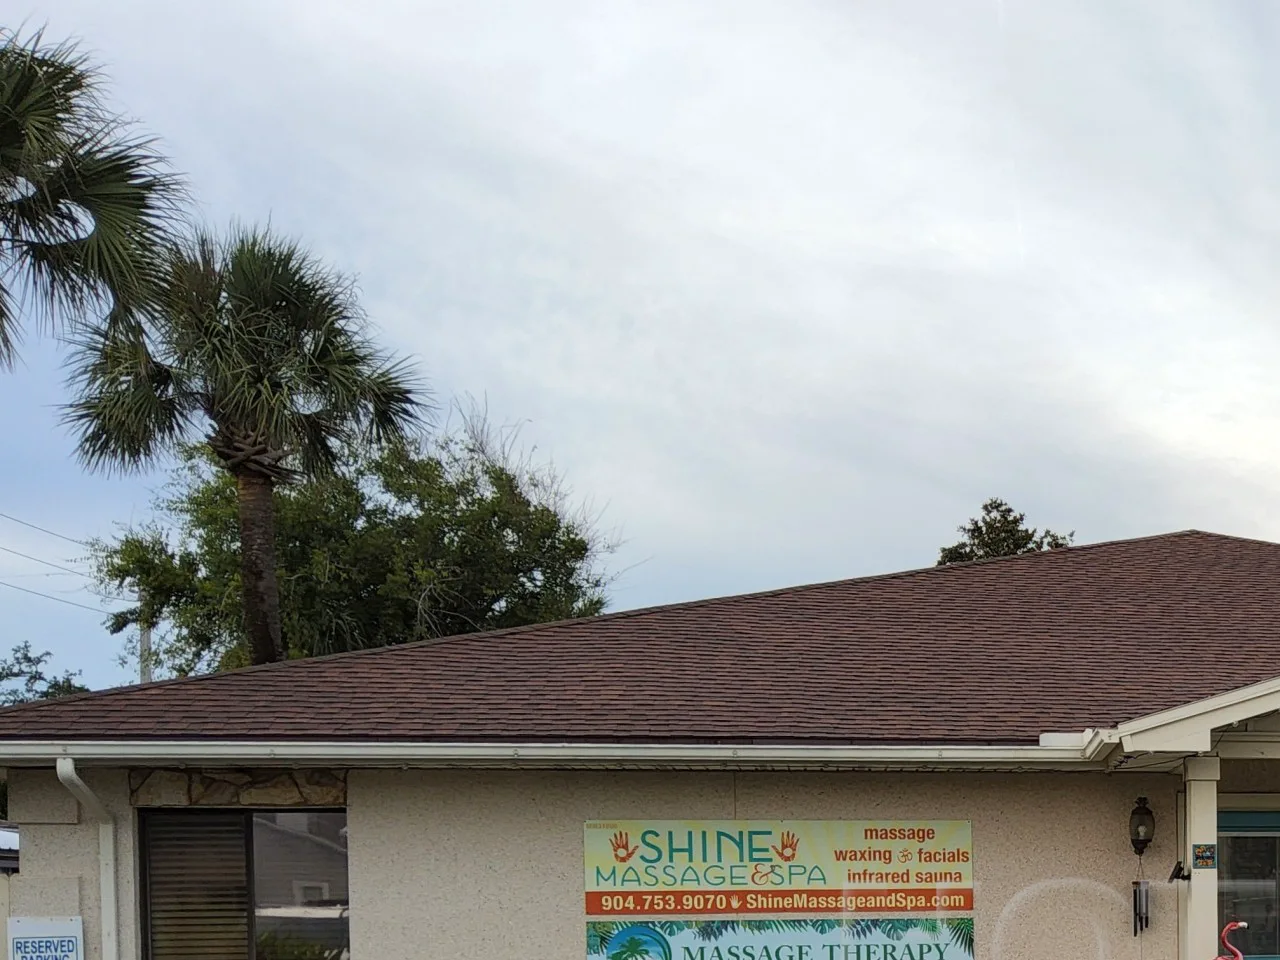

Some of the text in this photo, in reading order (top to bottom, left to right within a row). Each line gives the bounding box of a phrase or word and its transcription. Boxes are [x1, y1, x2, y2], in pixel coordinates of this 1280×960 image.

[864, 826, 935, 843] massage
[640, 829, 772, 864] SHINE
[834, 848, 969, 864] waxing facials
[848, 869, 962, 884] infrared sauna
[602, 893, 964, 911] 904.753.9070 ShineMassageandSpa.com
[16, 940, 74, 954] RESERVED
